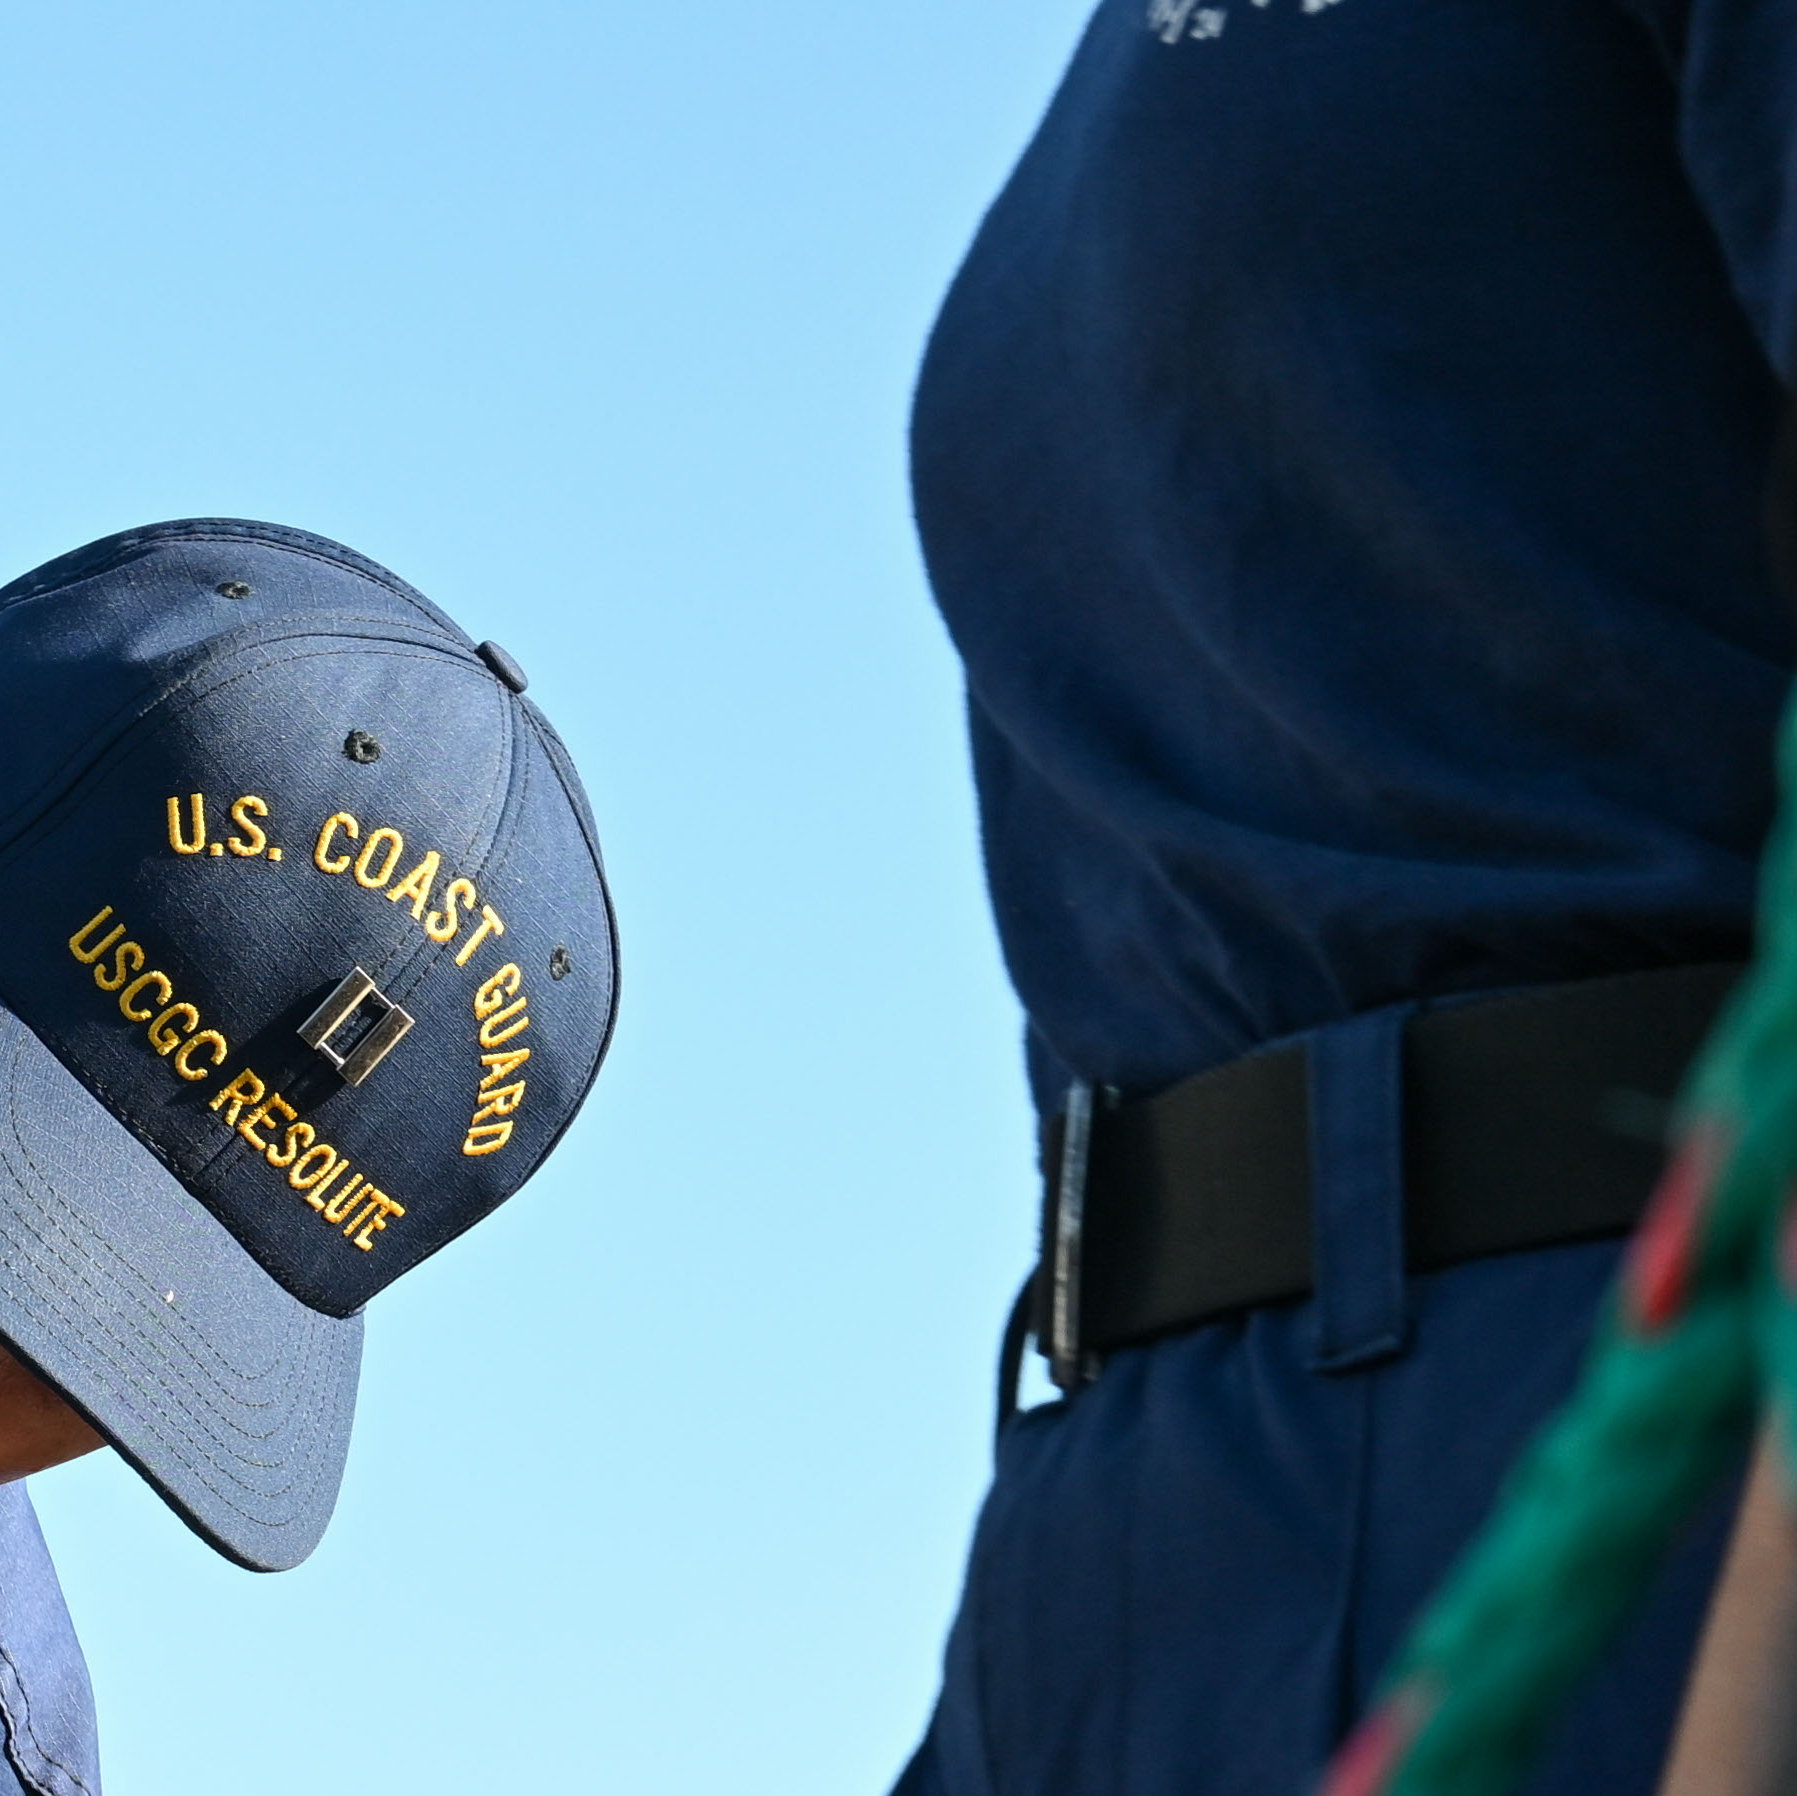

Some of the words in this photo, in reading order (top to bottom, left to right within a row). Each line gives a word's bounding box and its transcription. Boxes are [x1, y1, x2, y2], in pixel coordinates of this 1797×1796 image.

[68, 905, 228, 1081] USCGC
[209, 1067, 406, 1251] RESOLUTE
[167, 793, 283, 862] U.S.
[313, 811, 505, 967] COAST
[461, 962, 531, 1156] GUARD
